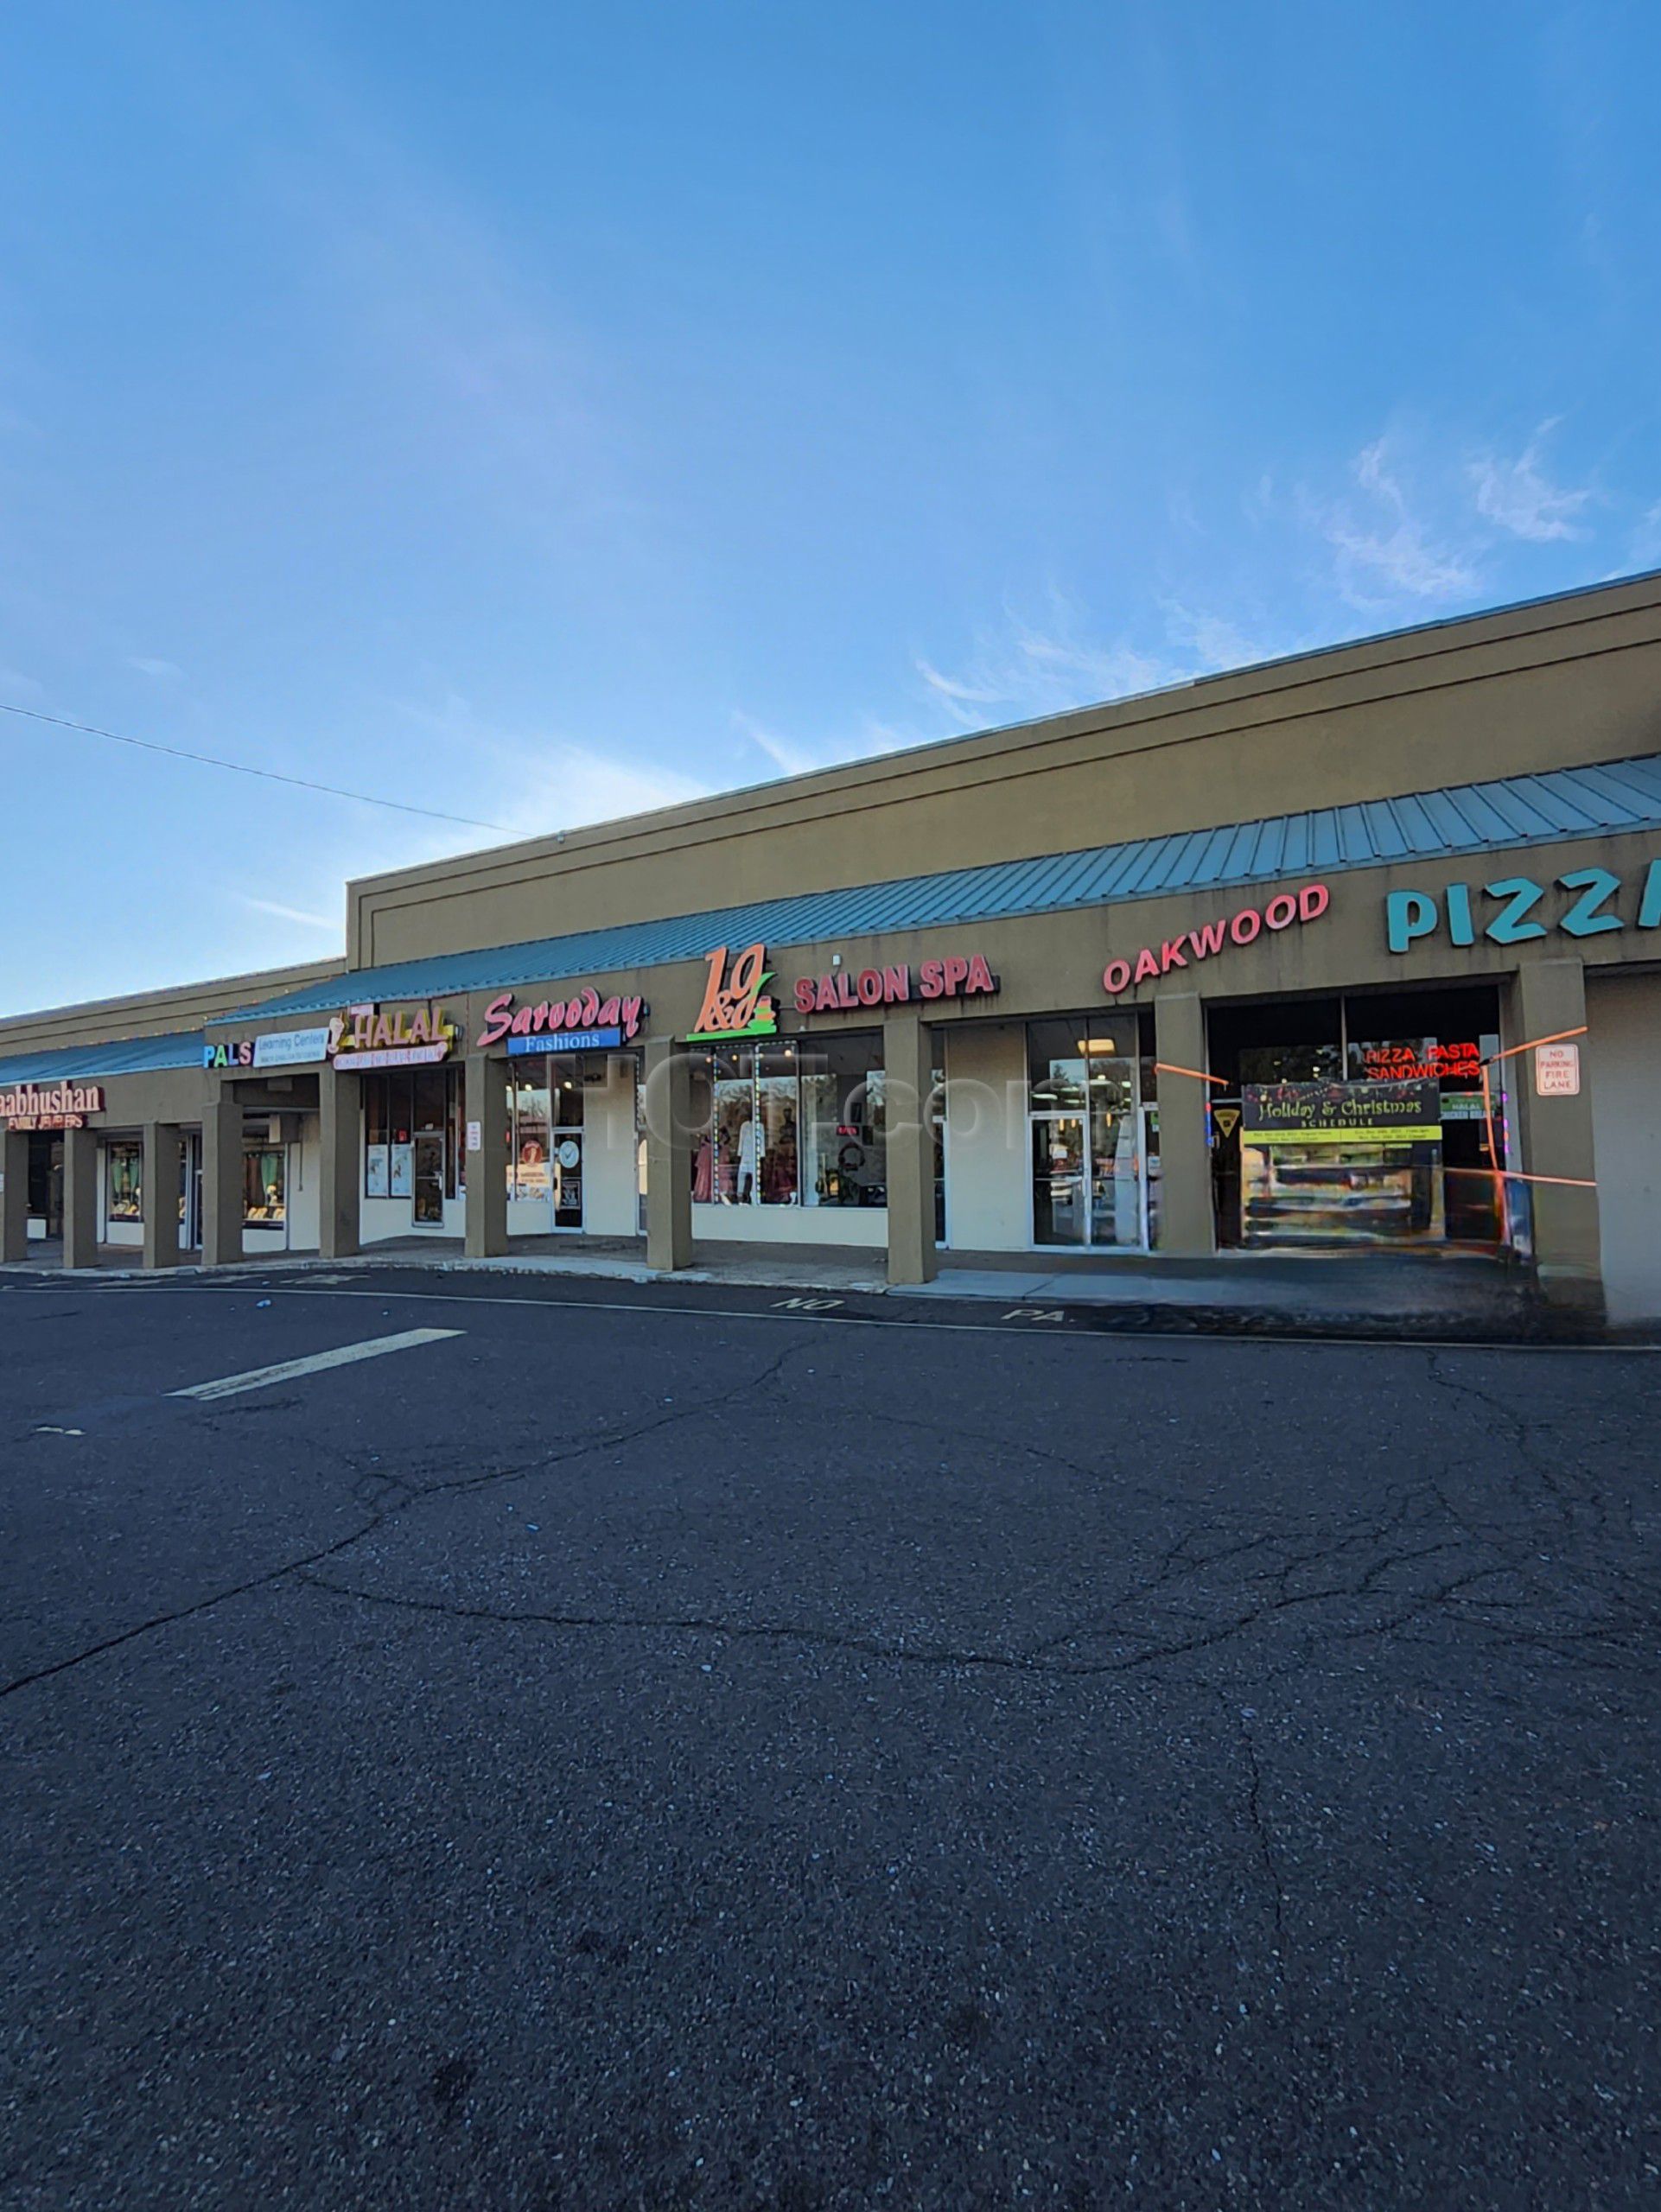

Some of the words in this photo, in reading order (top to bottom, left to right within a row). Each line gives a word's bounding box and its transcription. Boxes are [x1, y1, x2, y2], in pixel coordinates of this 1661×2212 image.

[1103, 884, 1329, 993] OAKWOOD
[794, 964, 909, 1014] SALON
[920, 954, 994, 998] SPA
[354, 1006, 449, 1049] HALAL
[525, 1033, 600, 1052] Fashions
[203, 1041, 251, 1068] PALS
[1365, 1047, 1416, 1064] PIZZA
[1428, 1042, 1480, 1059] PASTA
[1550, 1049, 1564, 1058] NO
[1366, 1060, 1480, 1079] SANDWICHES
[1545, 1071, 1570, 1079] FIRE
[1544, 1081, 1570, 1090] LANE
[1258, 1101, 1316, 1122] Holiday
[1341, 1098, 1422, 1116] Christmas
[1301, 1118, 1373, 1128] SCHEDULE
[769, 1297, 845, 1311] NO
